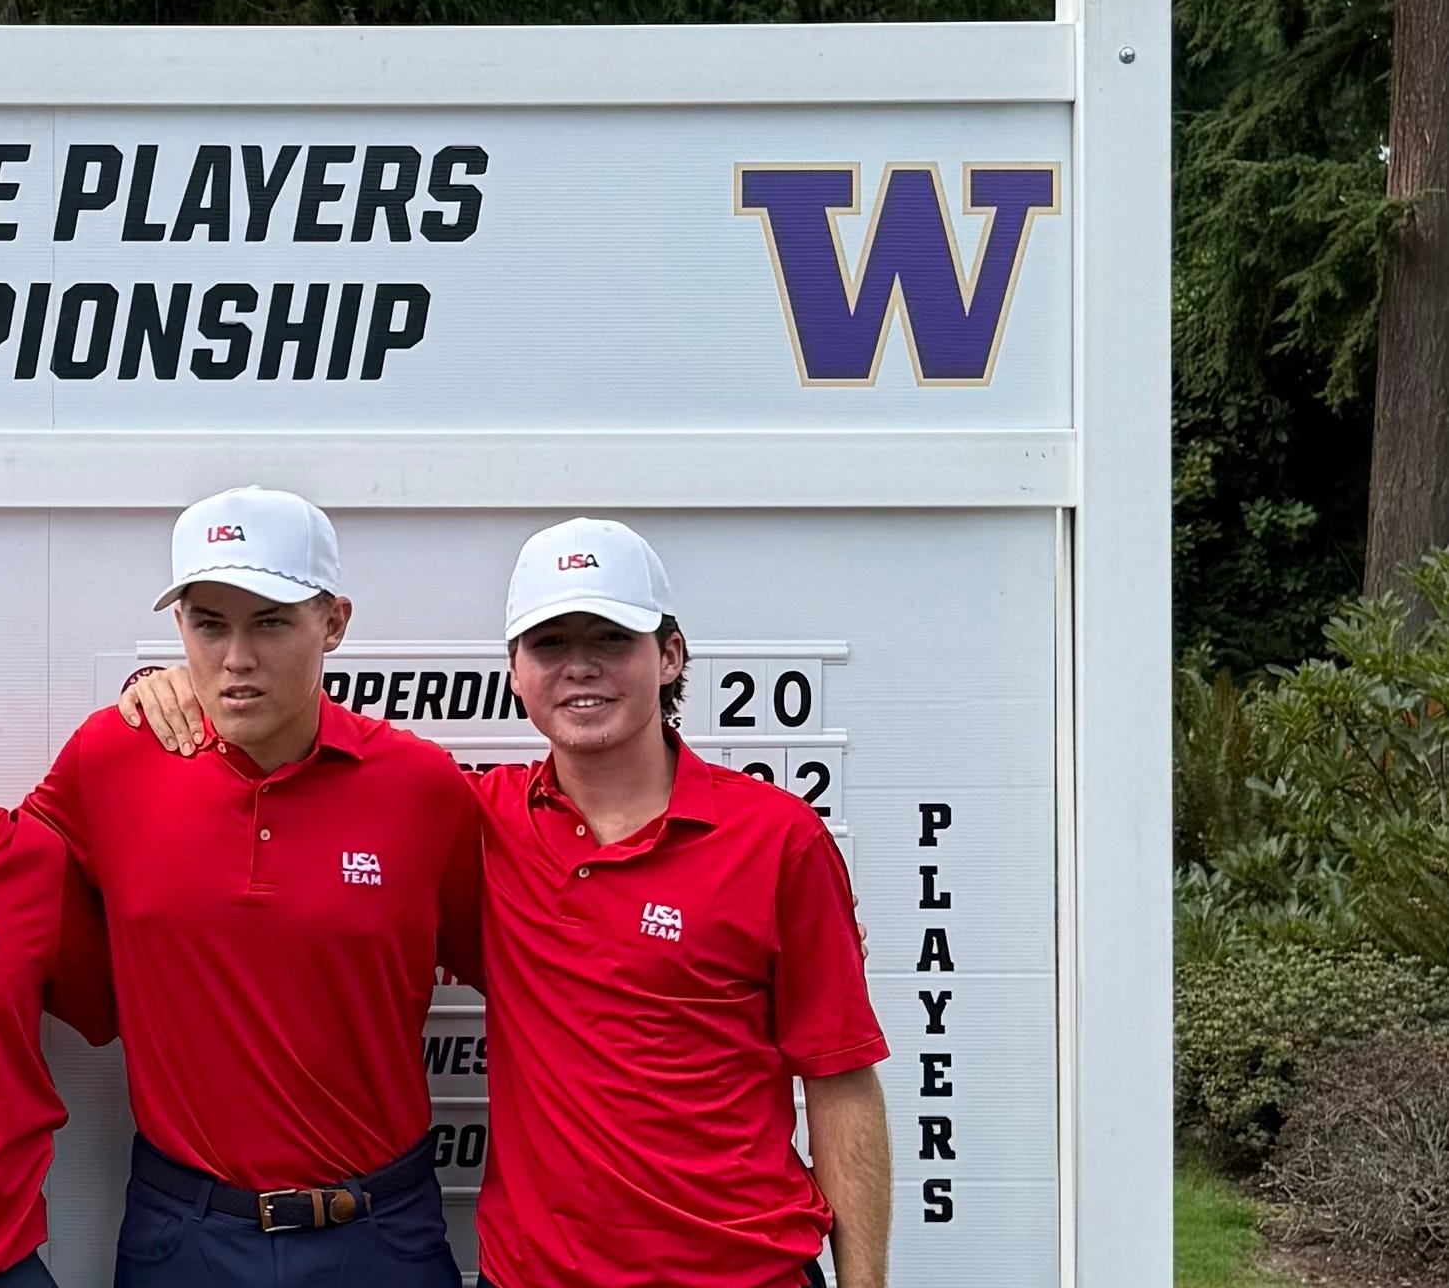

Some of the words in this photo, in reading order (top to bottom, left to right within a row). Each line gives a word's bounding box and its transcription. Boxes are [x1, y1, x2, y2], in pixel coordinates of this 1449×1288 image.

[53, 144, 489, 243] PLAYERS
[734, 162, 1061, 387] W
[207, 525, 246, 543] USA
[557, 554, 600, 571] USA
[719, 670, 812, 728] 20
[342, 851, 381, 872] USA
[341, 870, 382, 886] TEAM
[642, 902, 683, 930] USA
[640, 920, 681, 942] TEAM
[916, 803, 956, 1223] PLAYERS
